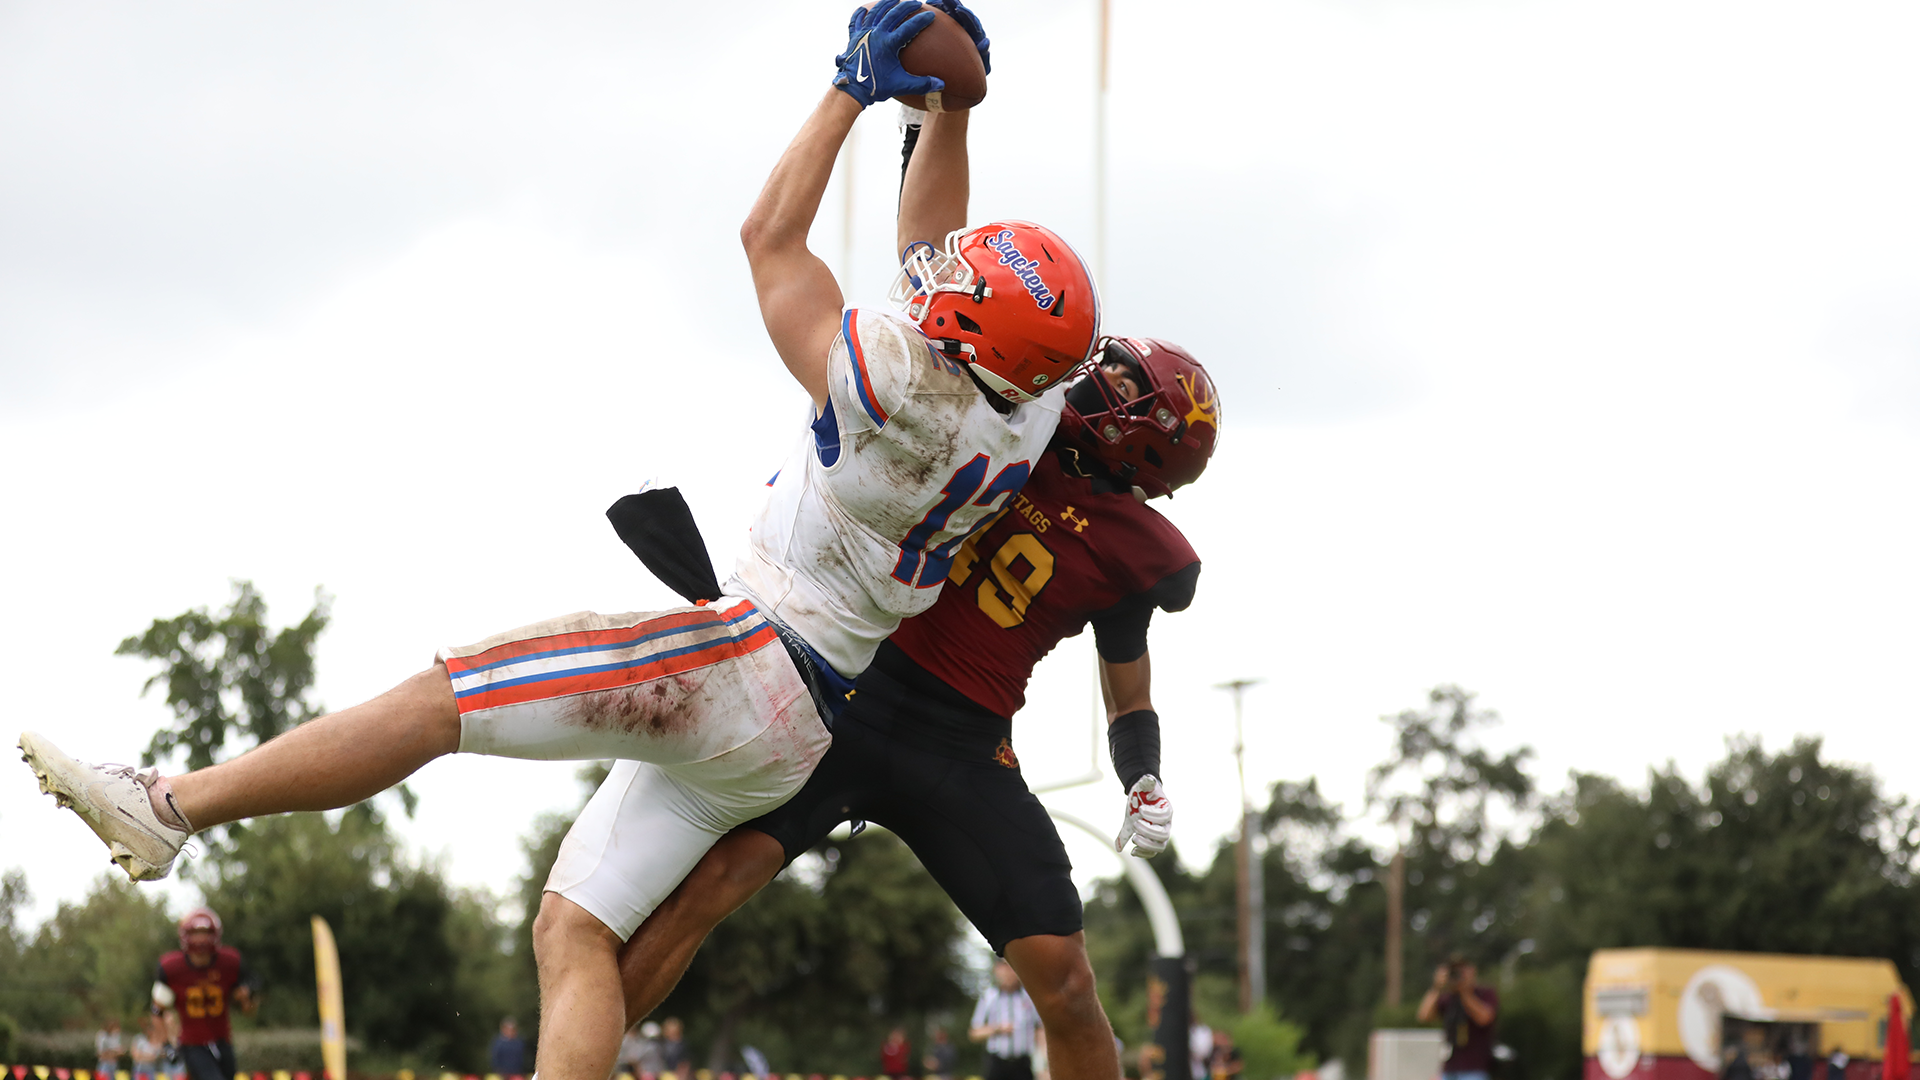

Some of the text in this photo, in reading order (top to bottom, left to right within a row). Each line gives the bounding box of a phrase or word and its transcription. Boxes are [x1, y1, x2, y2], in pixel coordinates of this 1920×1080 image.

[989, 229, 1056, 310] Sagehens
[890, 452, 1031, 589] 12
[1012, 491, 1052, 533] TAGS
